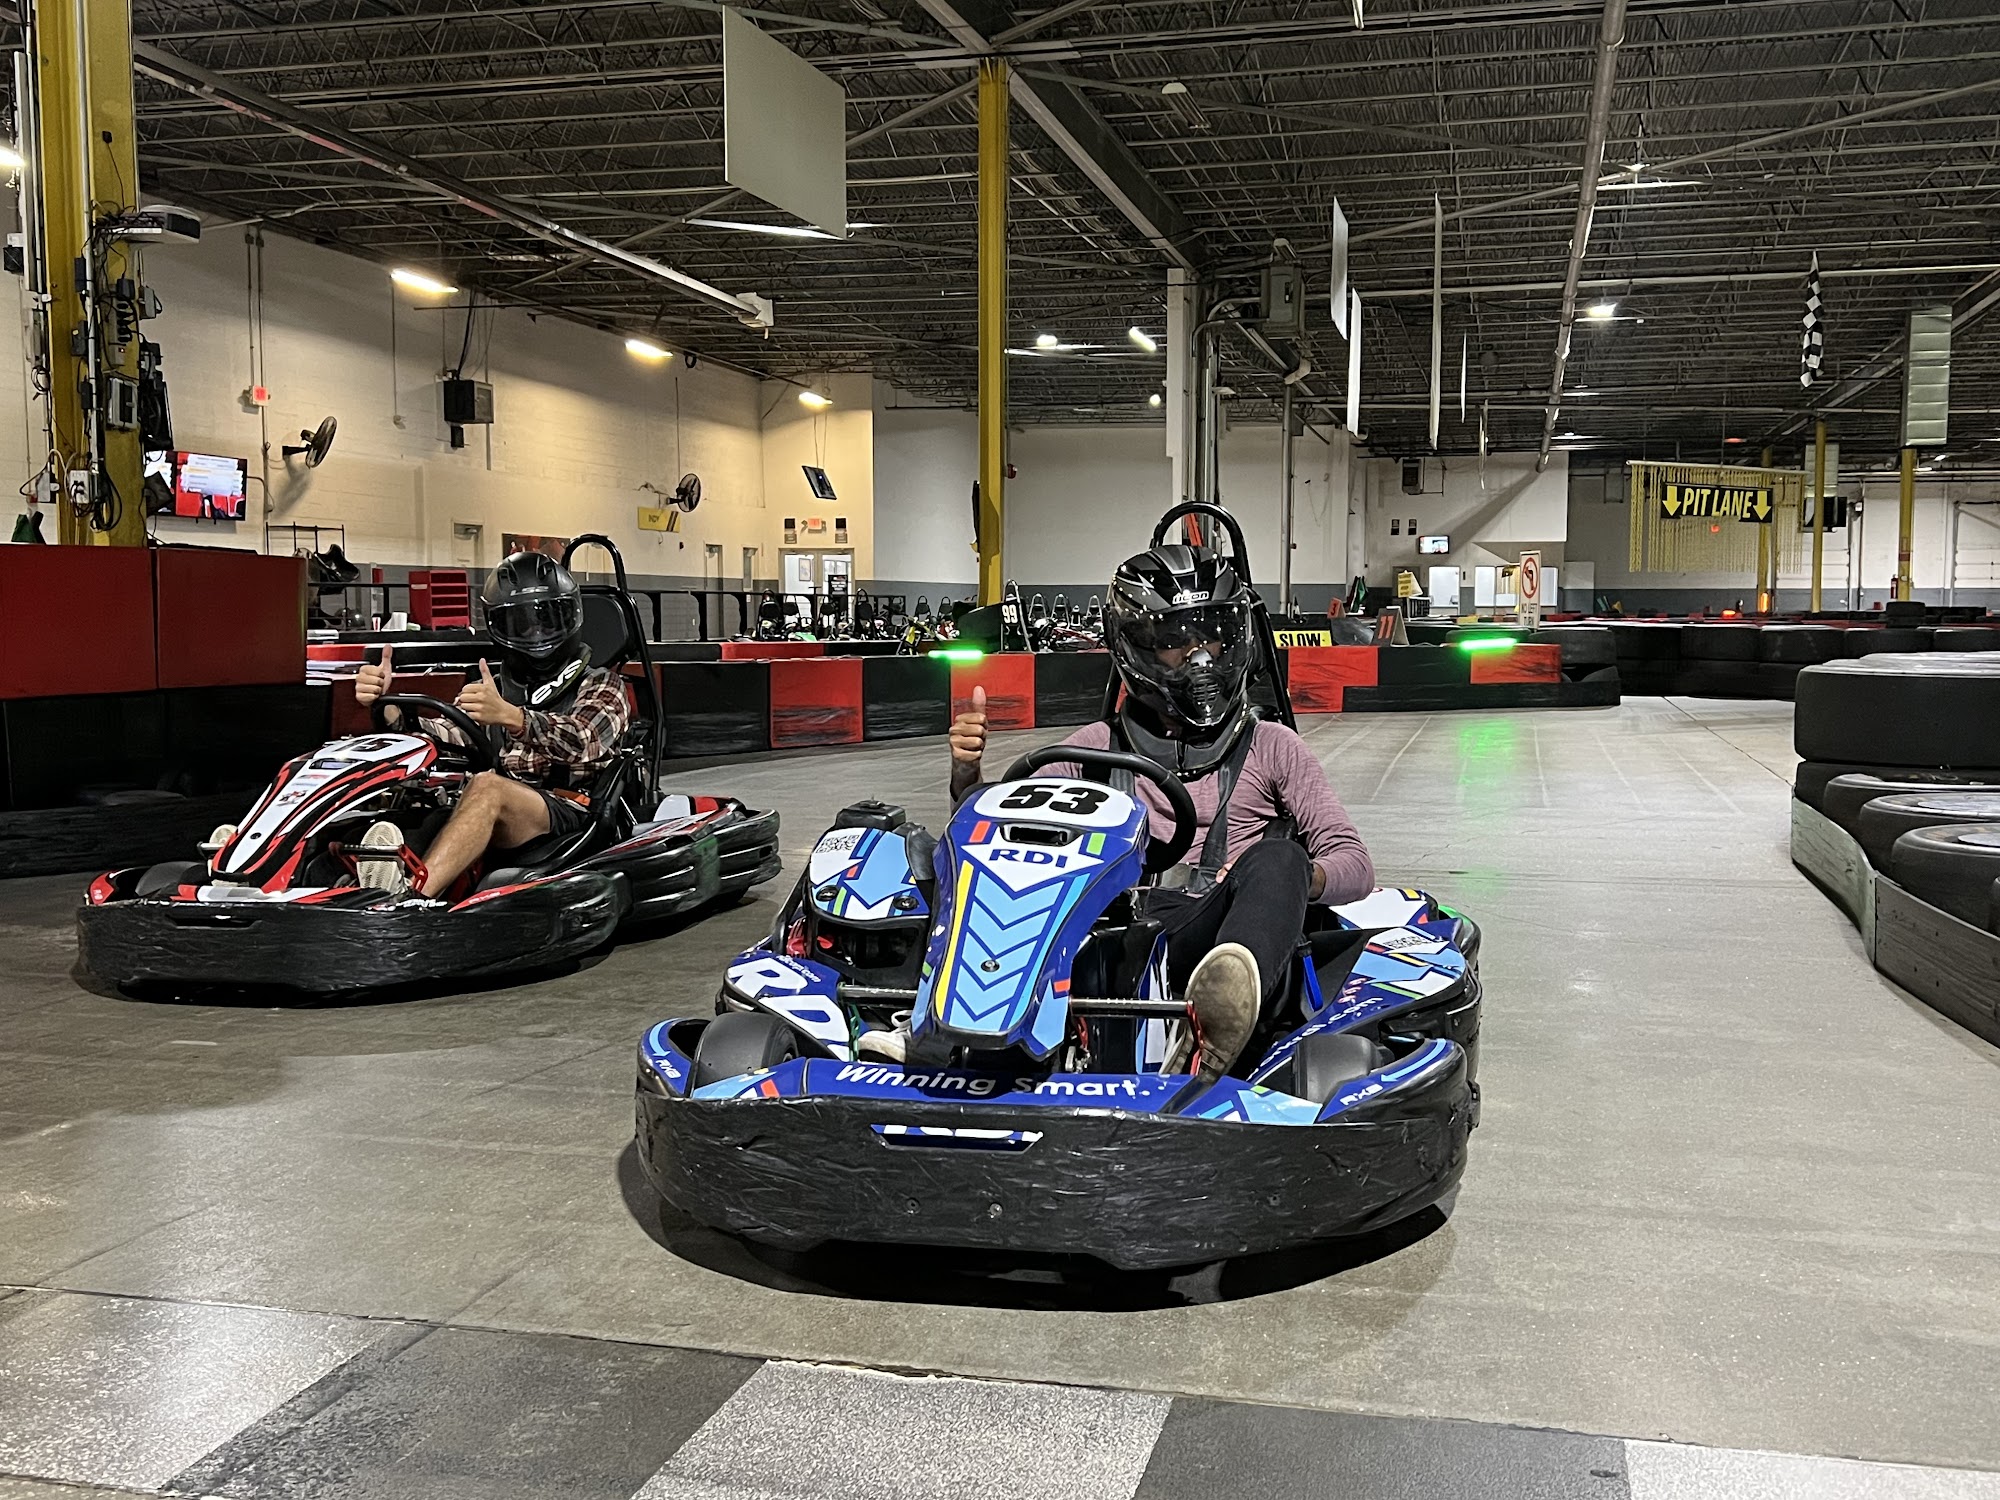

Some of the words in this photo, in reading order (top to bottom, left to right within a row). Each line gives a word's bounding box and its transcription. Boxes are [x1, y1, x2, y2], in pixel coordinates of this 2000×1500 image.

[1682, 487, 1711, 516] PIT
[1711, 489, 1754, 519] LANE
[1001, 604, 1019, 624] 99
[1377, 615, 1394, 639] 11
[1279, 632, 1321, 647] SLOW
[999, 784, 1110, 815] 53
[989, 848, 1068, 869] RDI
[835, 1064, 997, 1096] Winning
